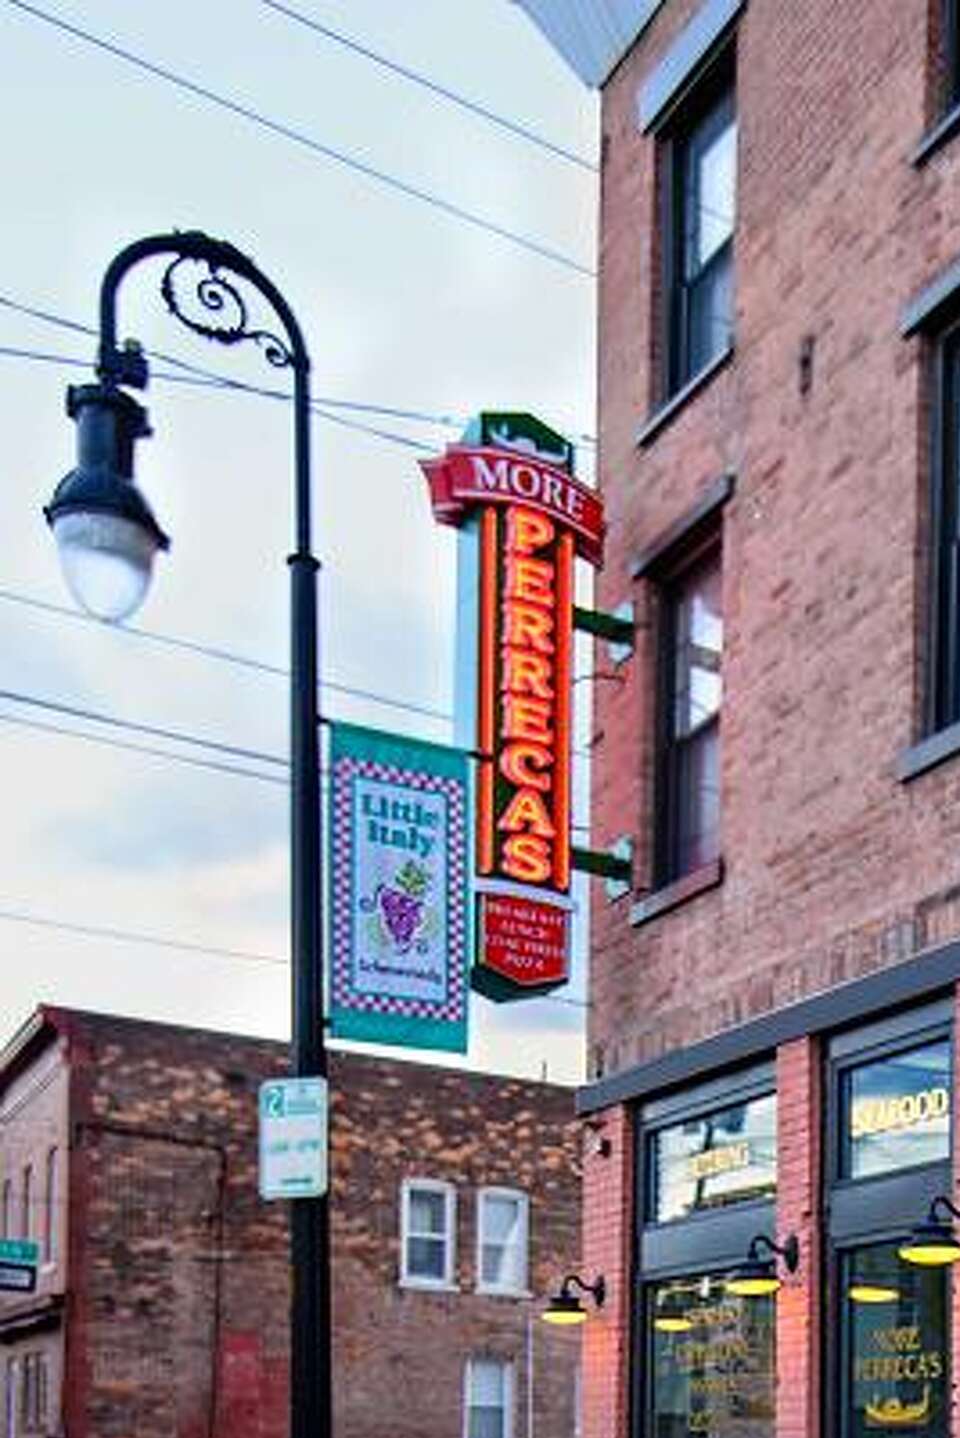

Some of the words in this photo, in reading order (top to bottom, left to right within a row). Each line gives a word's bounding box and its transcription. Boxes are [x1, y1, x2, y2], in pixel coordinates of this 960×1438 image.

[470, 455, 584, 520] MORE
[362, 794, 440, 827] Little
[368, 819, 436, 858] Italy
